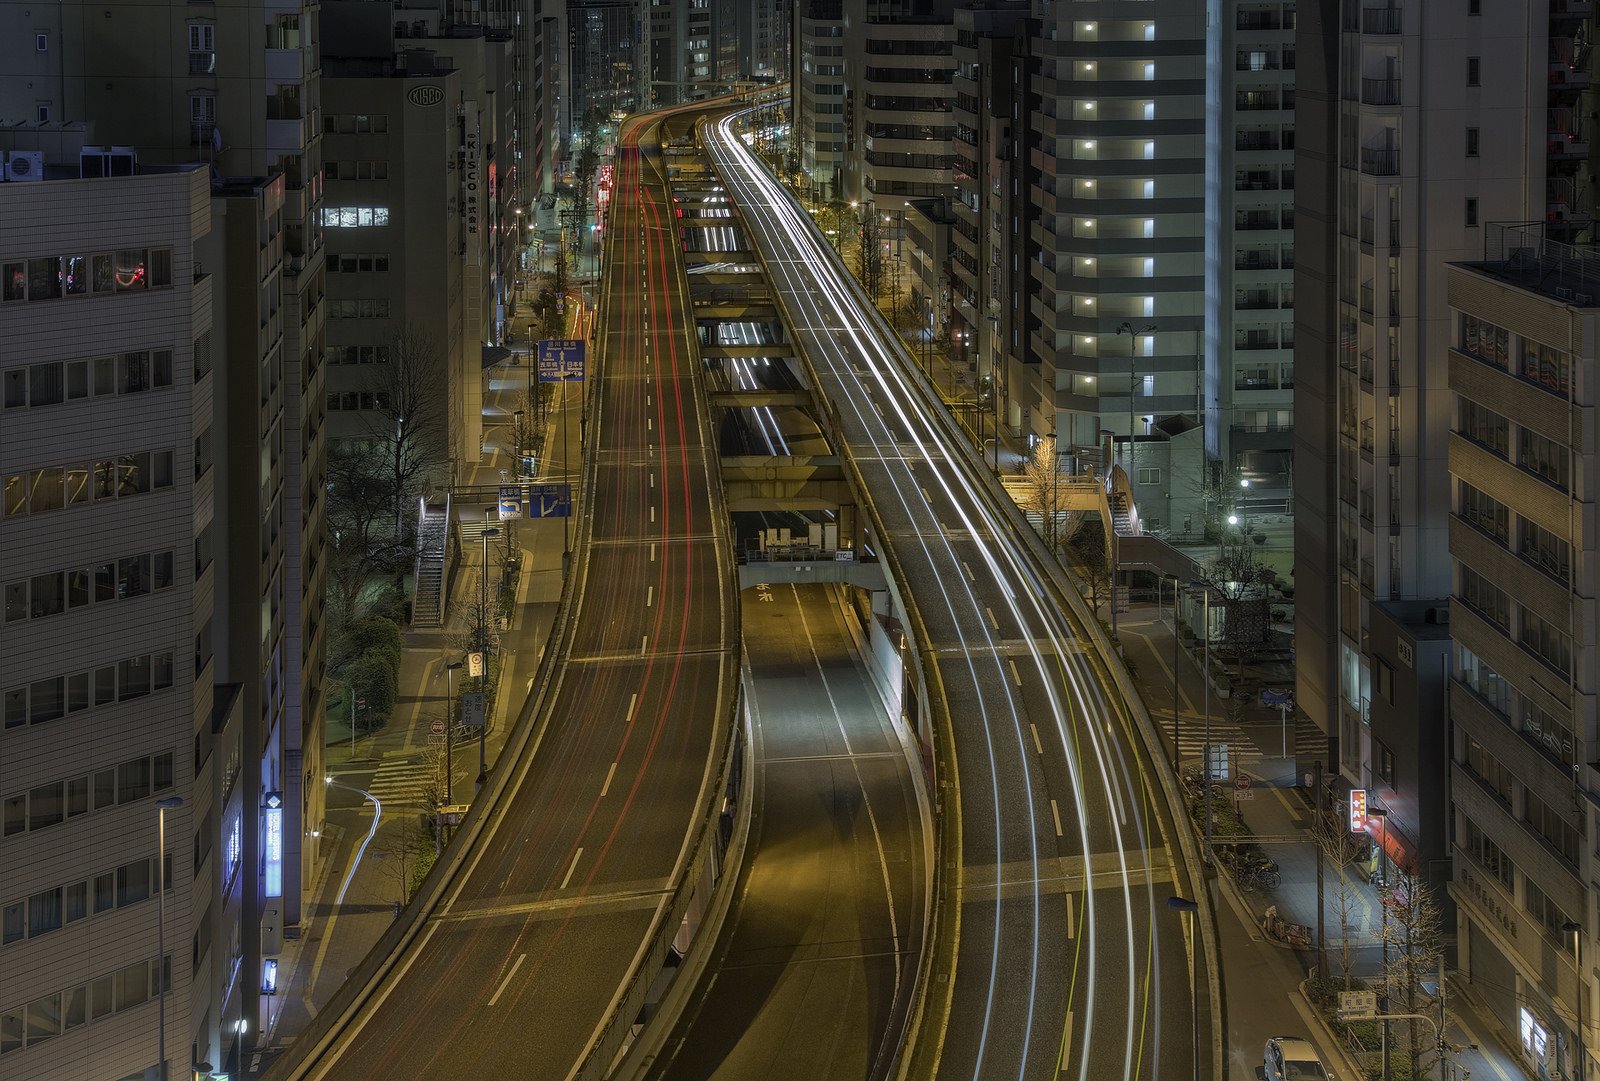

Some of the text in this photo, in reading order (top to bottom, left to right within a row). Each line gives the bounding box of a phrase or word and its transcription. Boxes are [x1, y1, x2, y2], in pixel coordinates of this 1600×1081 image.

[411, 87, 442, 105] KISCO
[467, 141, 477, 191] KISCO
[468, 196, 477, 234] 株式会社
